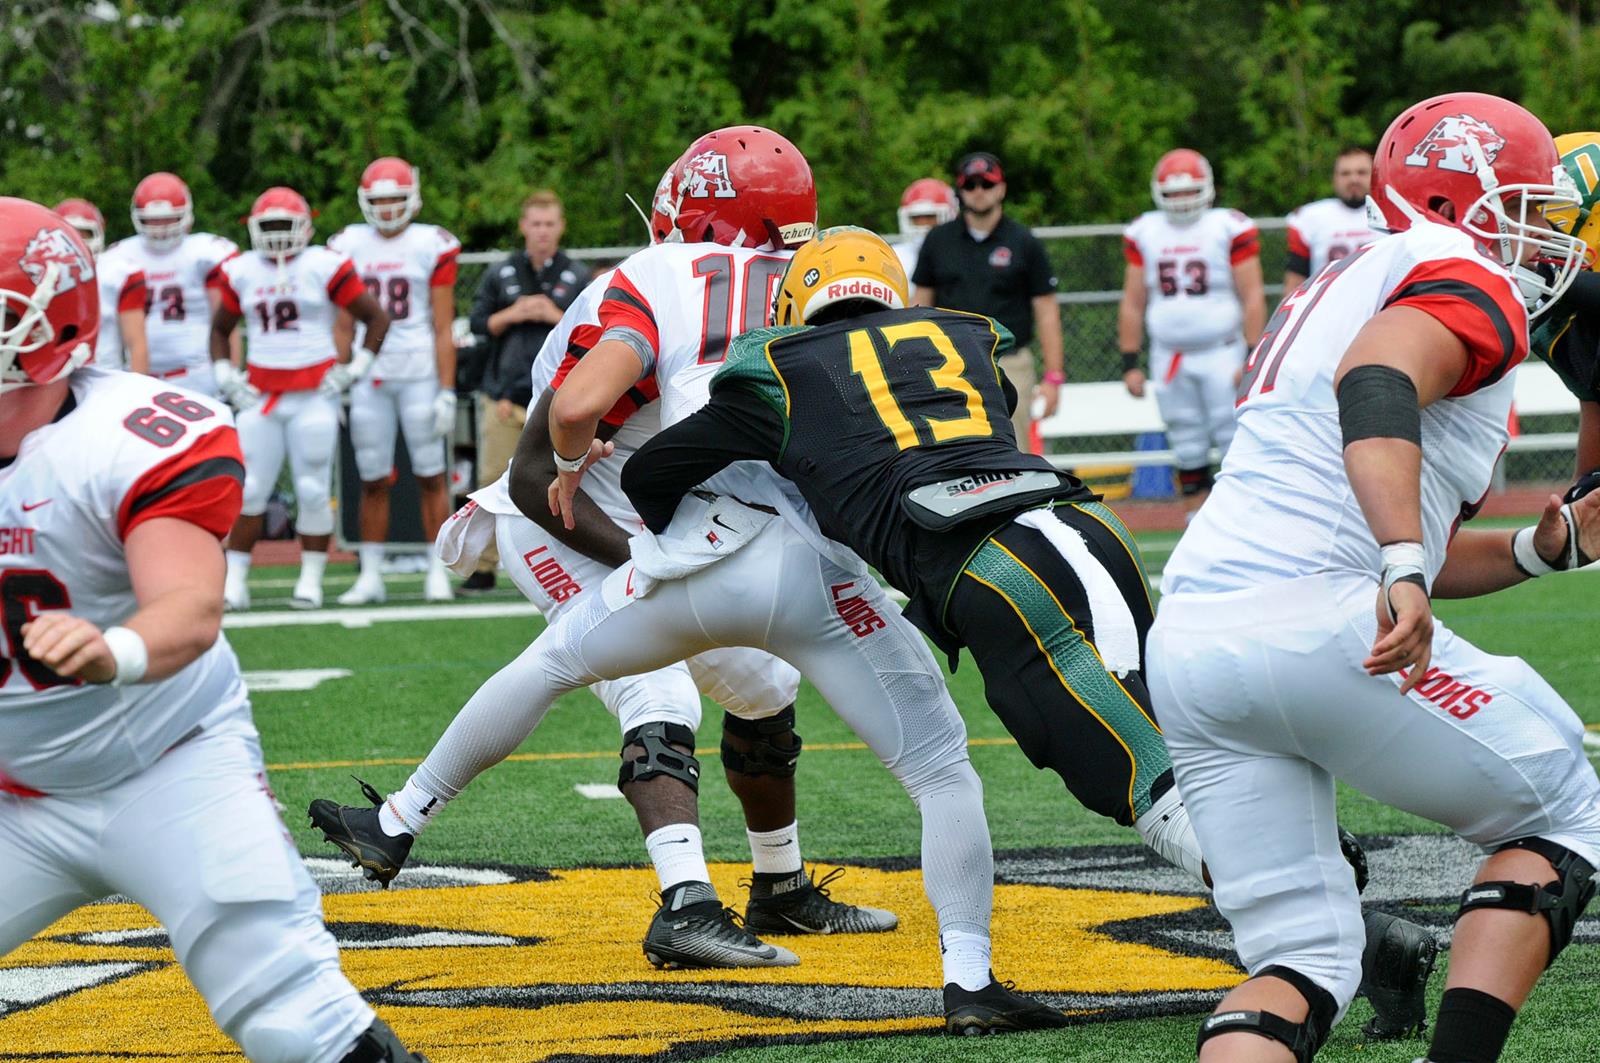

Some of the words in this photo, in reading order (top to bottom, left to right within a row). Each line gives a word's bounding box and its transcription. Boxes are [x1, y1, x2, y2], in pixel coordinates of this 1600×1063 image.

[780, 226, 812, 240] chutt
[804, 268, 819, 287] DC
[828, 281, 893, 305] Riddell
[1158, 260, 1208, 296] 53
[254, 299, 298, 332] 12
[846, 319, 993, 452] 13
[123, 391, 216, 448] 66
[0, 528, 35, 555] GHT
[523, 545, 582, 603] LIONS
[831, 581, 887, 638] LIONS
[0, 568, 85, 692] 6
[1397, 666, 1493, 720] ONS
[771, 876, 797, 896] NIKE
